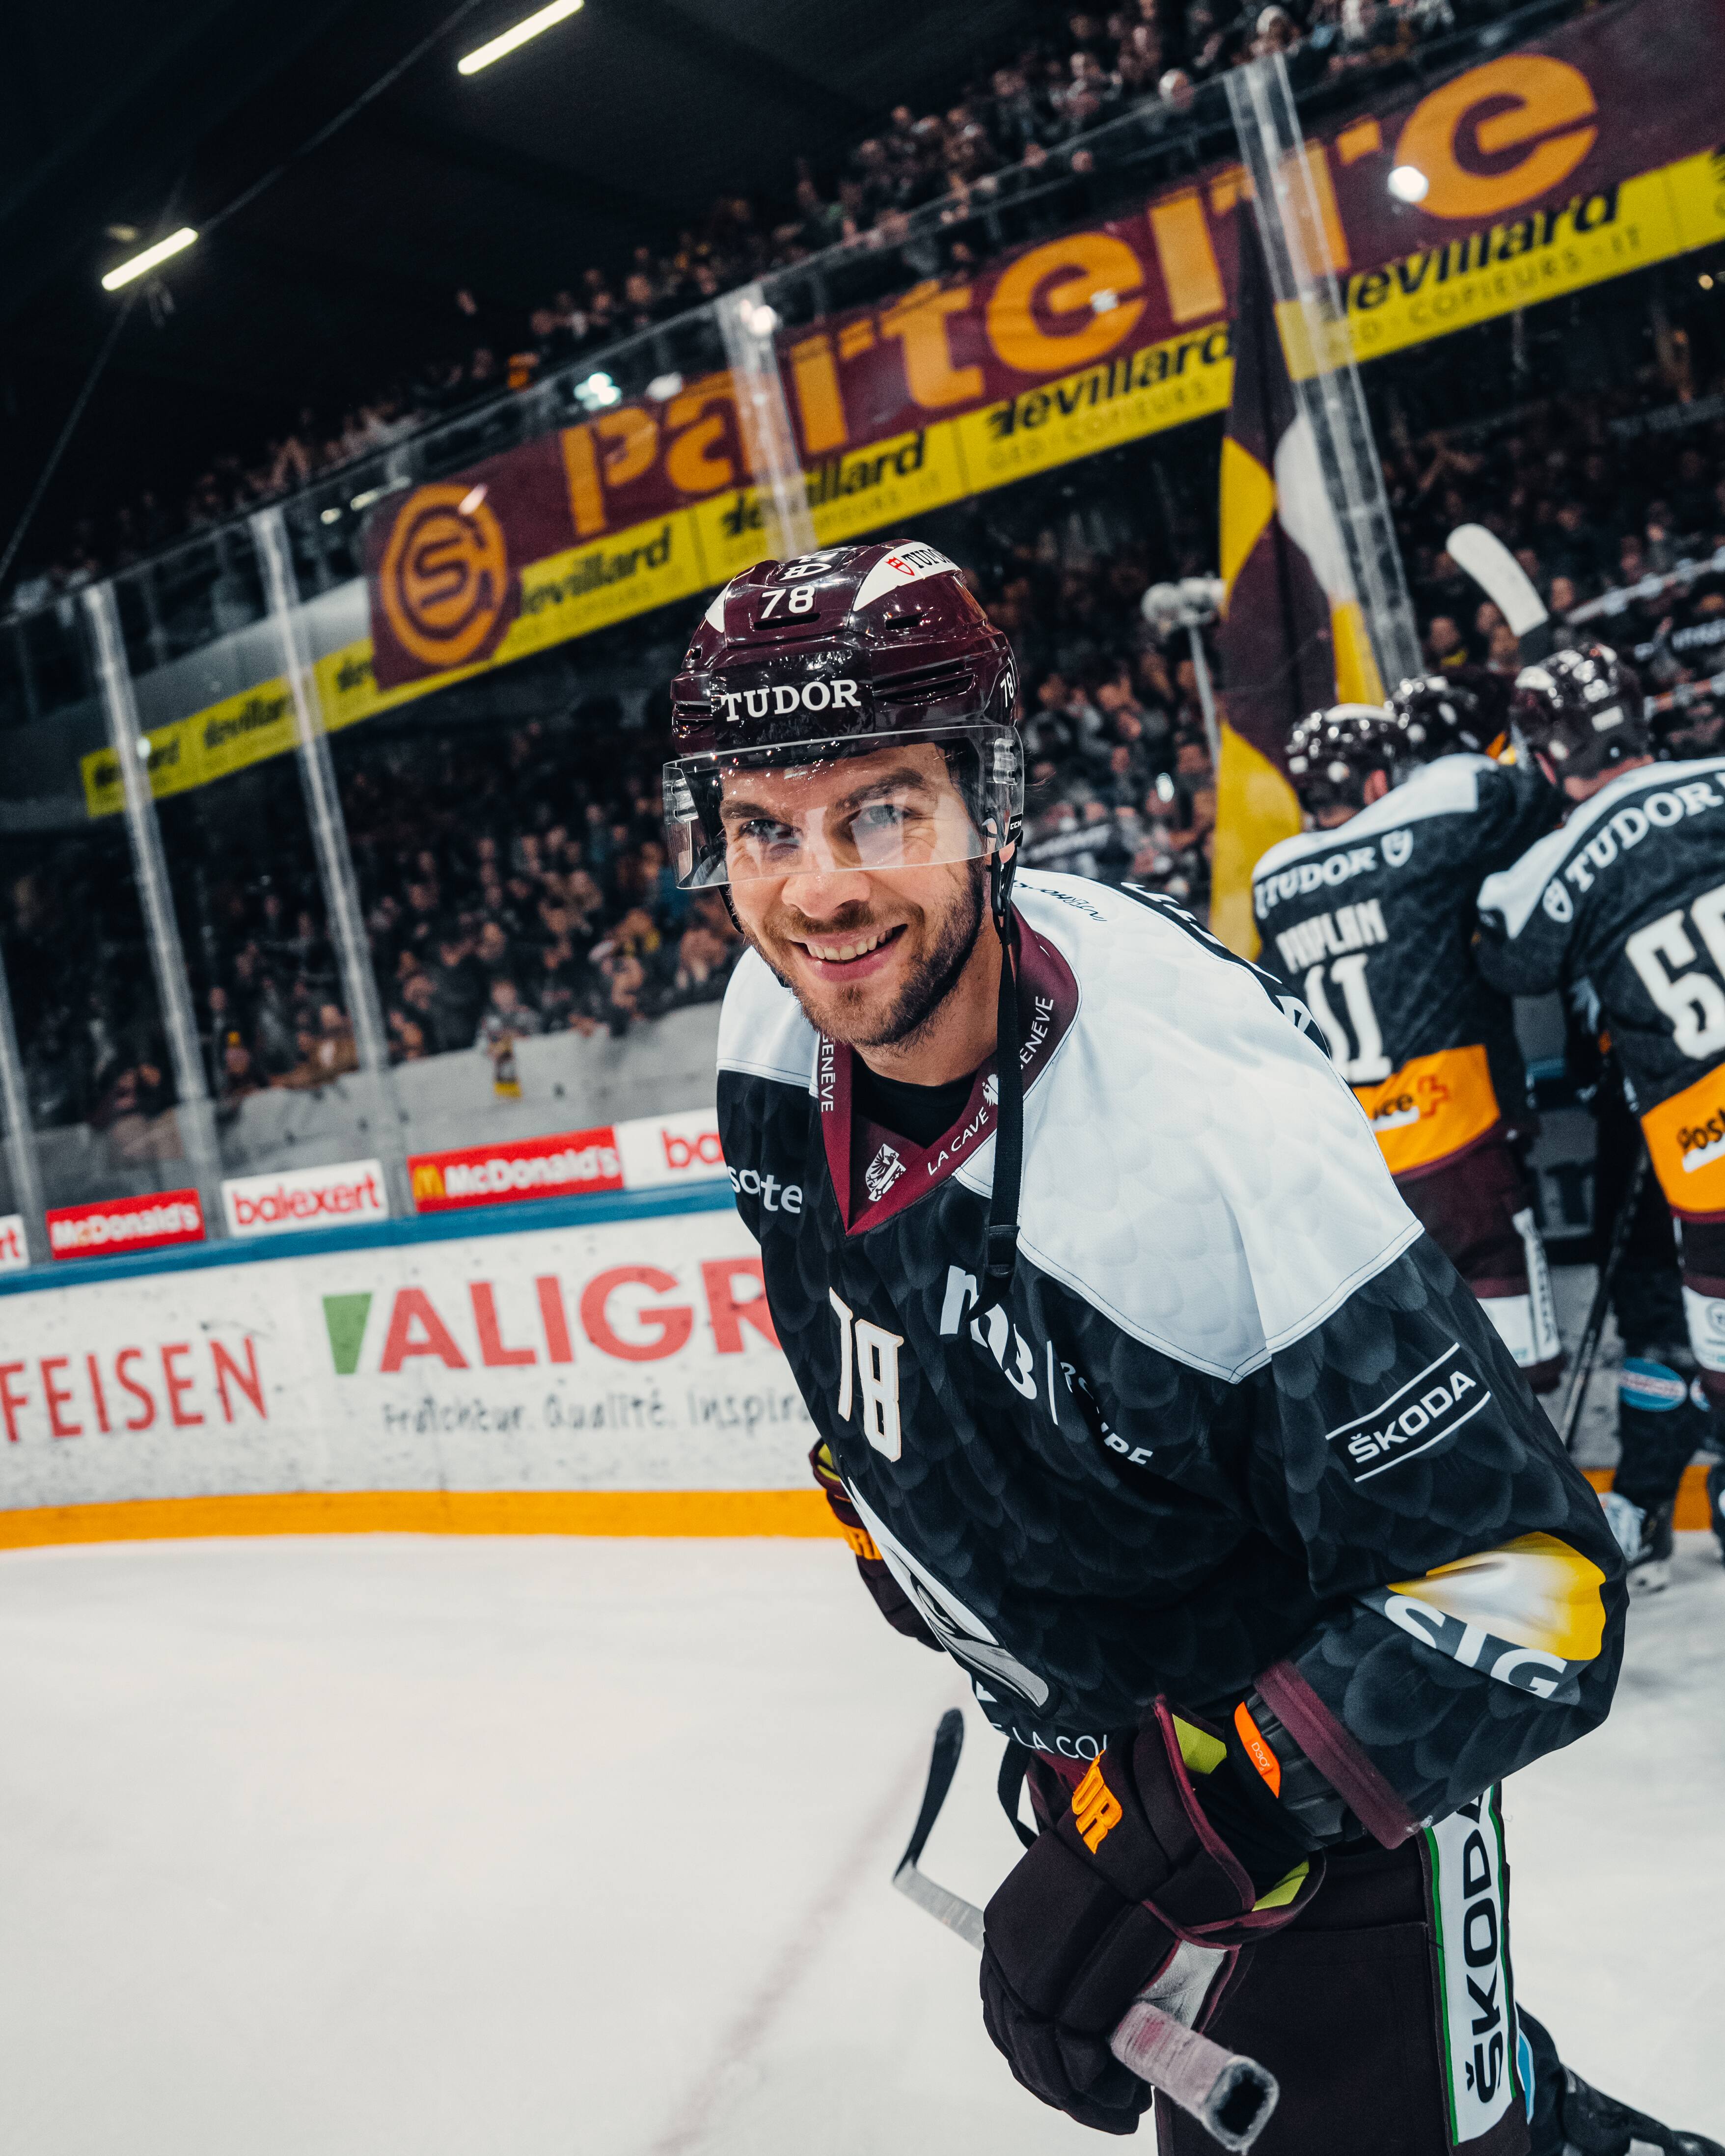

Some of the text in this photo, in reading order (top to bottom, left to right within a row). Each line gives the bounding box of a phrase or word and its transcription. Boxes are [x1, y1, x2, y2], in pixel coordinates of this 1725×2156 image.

[902, 548, 952, 569] TUDO
[761, 585, 815, 619] 78
[720, 680, 861, 722] TUDOR
[1000, 671, 1014, 708] 78
[1010, 819, 1022, 830] CCM
[1564, 782, 1725, 893] TUDOR
[928, 1107, 989, 1176] LA CAVE
[444, 1146, 621, 1197] McDonald's
[233, 1173, 382, 1226] balexert
[53, 1202, 201, 1251] McDonald's
[379, 1257, 783, 1373] ALIGR
[828, 1286, 904, 1462] 78
[1347, 1370, 1477, 1463] ŠKODA
